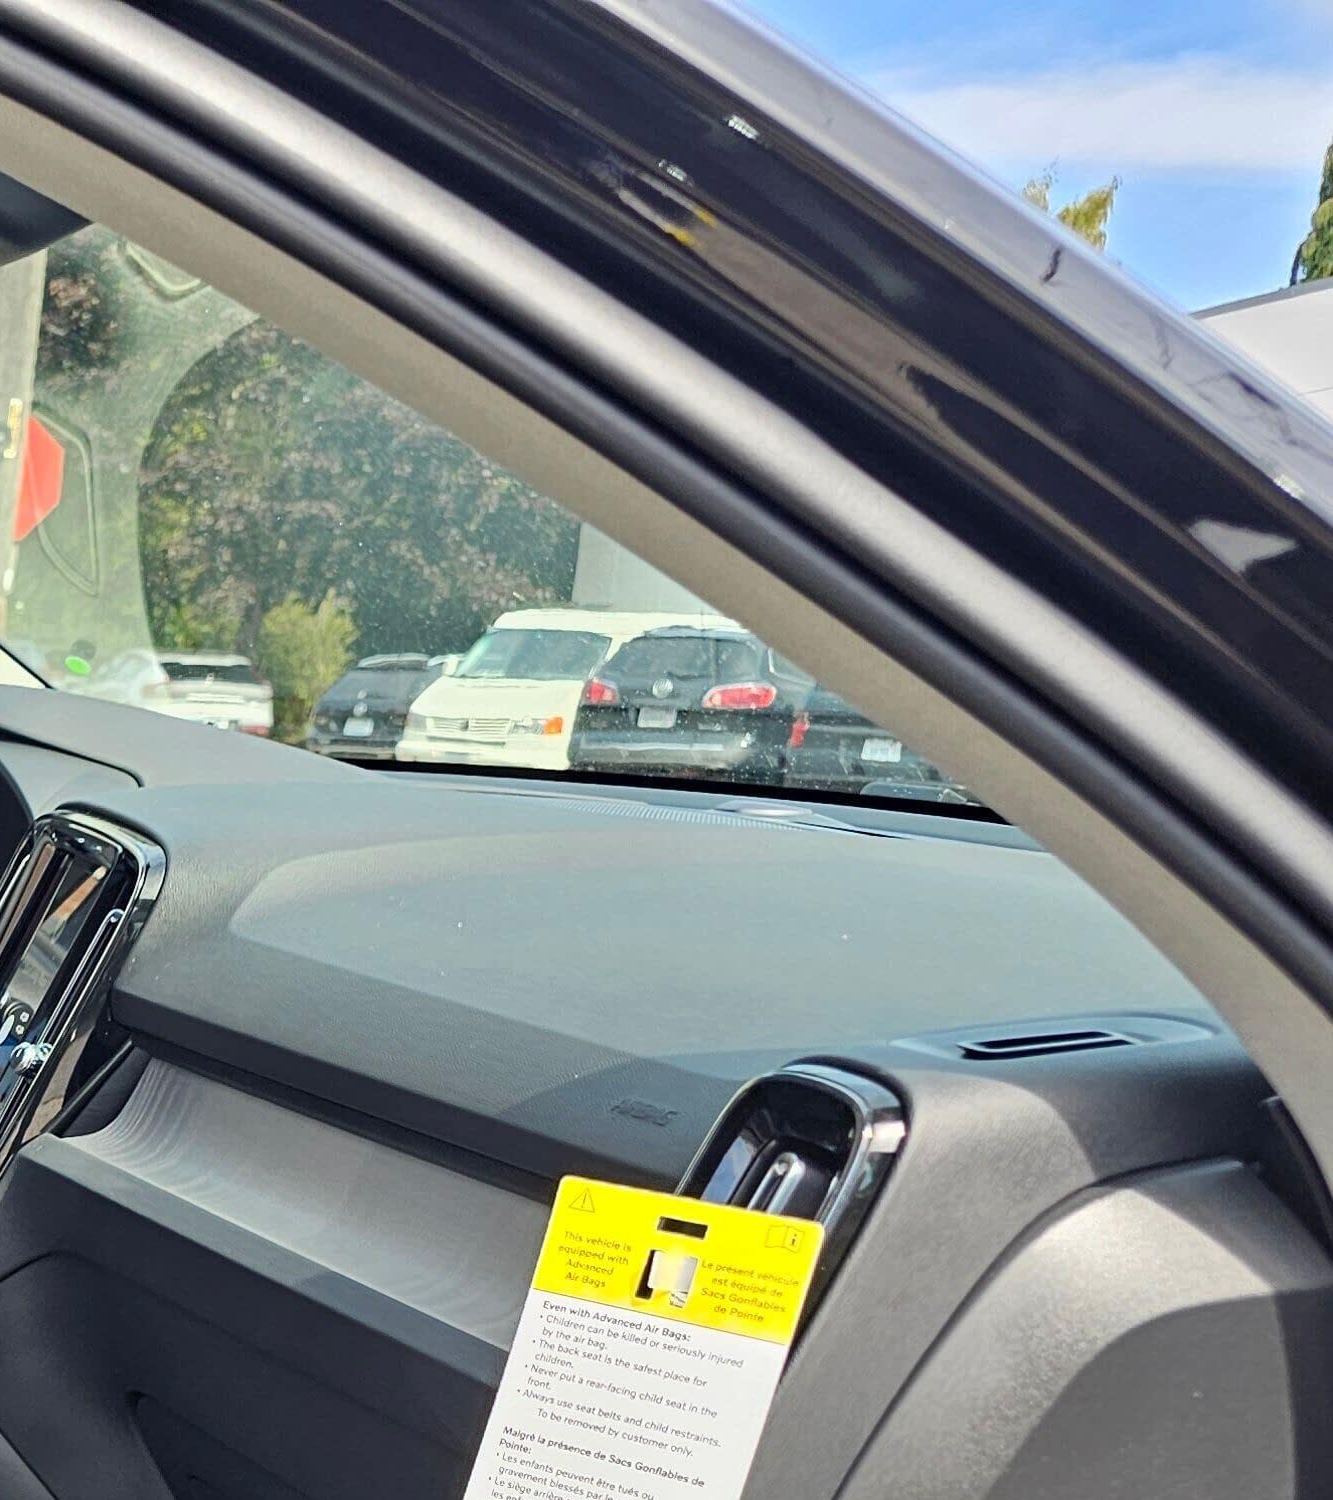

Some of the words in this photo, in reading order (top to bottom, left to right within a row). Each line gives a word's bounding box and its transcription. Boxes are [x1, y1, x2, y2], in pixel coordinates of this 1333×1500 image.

[701, 1259, 714, 1270] Le
[542, 1300, 567, 1313] Even
[569, 1308, 591, 1318] with
[592, 1312, 643, 1331] Advanced
[643, 1323, 660, 1334] Air
[661, 1327, 691, 1342] Bags:
[542, 1326, 554, 1339] by
[555, 1330, 572, 1341] the
[572, 1335, 586, 1344] air
[586, 1336, 608, 1351] bag.
[546, 1314, 586, 1331] Children
[586, 1325, 605, 1336] can
[606, 1328, 620, 1339] be
[621, 1331, 649, 1346] killed
[649, 1339, 661, 1349] or
[661, 1343, 706, 1361] seriously
[707, 1351, 745, 1369] injured
[534, 1352, 574, 1369] children.
[539, 1338, 556, 1351] The
[557, 1343, 580, 1357] back
[581, 1351, 603, 1362] seat
[603, 1354, 612, 1365] is
[614, 1357, 631, 1369] the
[633, 1363, 663, 1377] safest
[663, 1370, 691, 1384] place
[692, 1375, 708, 1387] for
[527, 1375, 551, 1391] front.
[530, 1363, 559, 1378] Never
[558, 1372, 577, 1383] put
[585, 1379, 637, 1400] rear-facing
[638, 1391, 664, 1405] child
[665, 1399, 687, 1411] seat
[688, 1403, 698, 1413] in
[700, 1406, 718, 1419] the
[521, 1388, 555, 1405] Always
[556, 1399, 574, 1410] use
[575, 1404, 596, 1416] seat
[597, 1407, 622, 1422] belts
[623, 1416, 644, 1427] and
[644, 1421, 670, 1434] child
[670, 1428, 721, 1448] restraints.
[537, 1407, 548, 1419] To
[549, 1411, 562, 1423] be
[563, 1416, 607, 1434] removed
[607, 1426, 620, 1439] by
[621, 1431, 669, 1450] customer
[670, 1445, 694, 1458] only.
[498, 1437, 532, 1455] Pointe:
[536, 1434, 546, 1445] la
[593, 1450, 607, 1461] de
[608, 1454, 632, 1468] Sacs
[634, 1461, 689, 1483] Gonflables
[691, 1477, 705, 1488] de
[494, 1475, 506, 1487] Le
[498, 1466, 548, 1486] gravement
[585, 1490, 604, 1500] par
[502, 1451, 518, 1464] Les
[519, 1459, 554, 1474] enfants
[554, 1469, 595, 1486] peuvent
[490, 1488, 504, 1500] les
